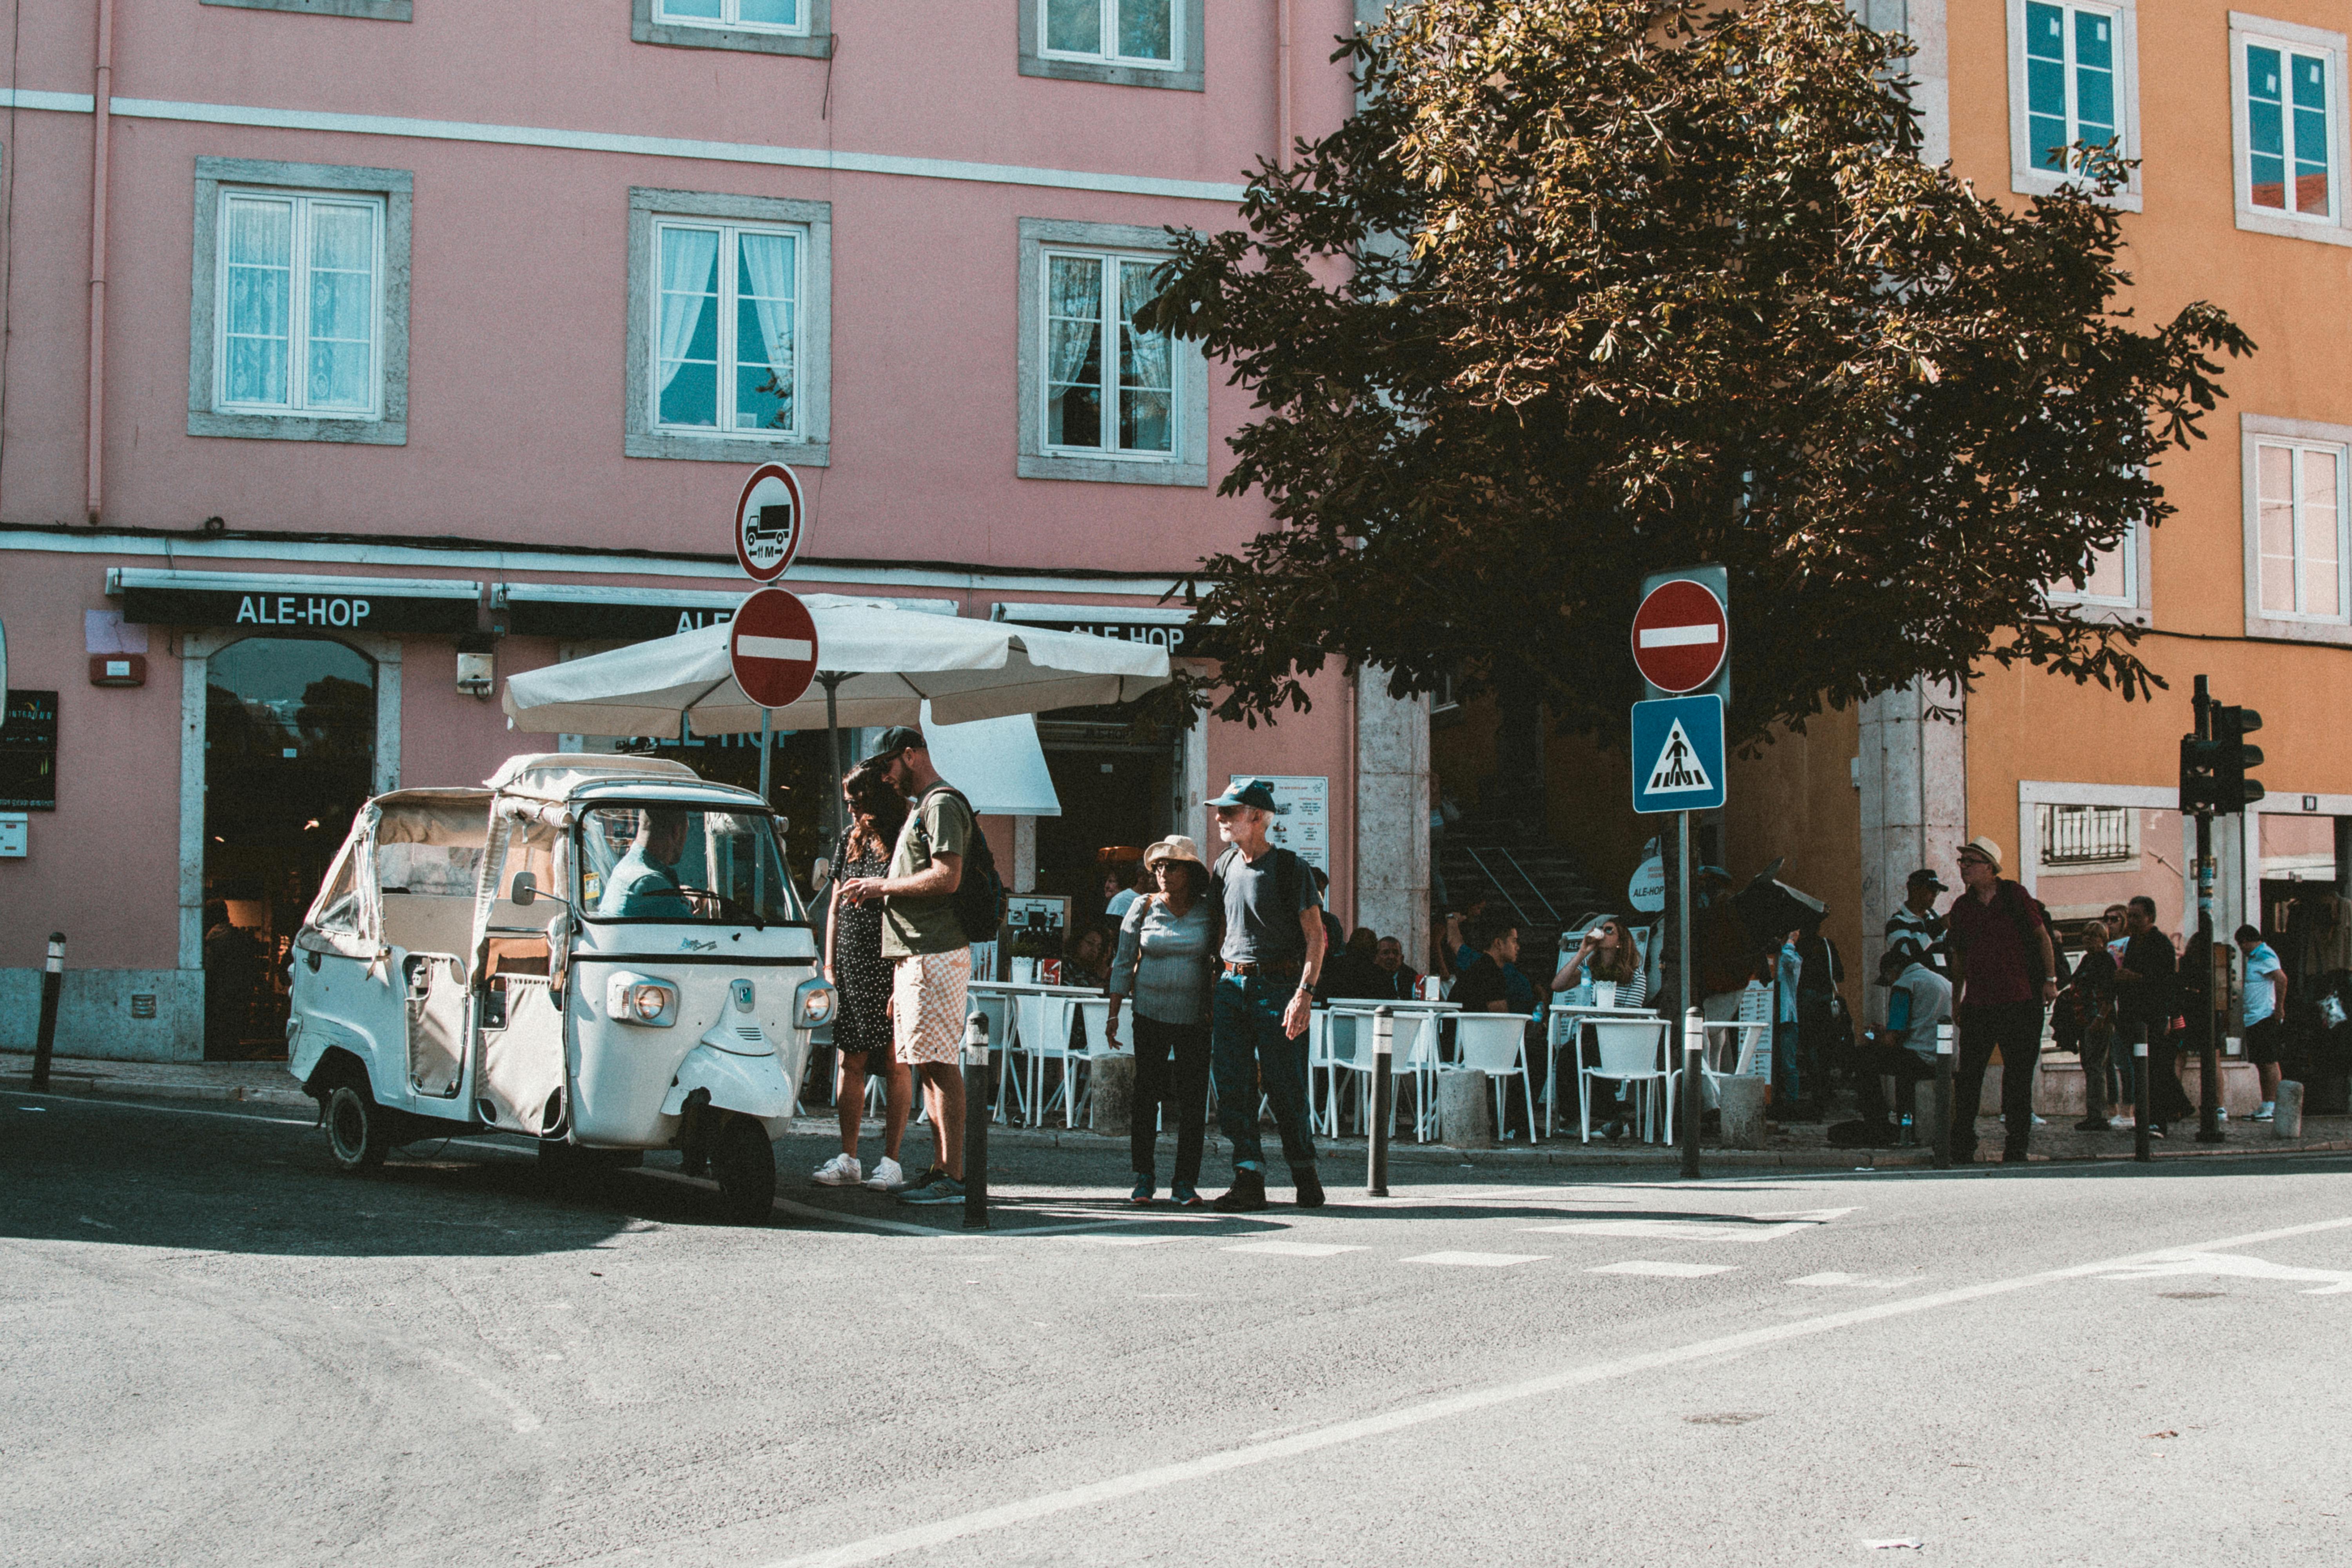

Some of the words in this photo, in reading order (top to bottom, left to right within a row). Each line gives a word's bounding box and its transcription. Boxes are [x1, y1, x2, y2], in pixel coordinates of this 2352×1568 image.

[765, 546, 774, 557] M
[236, 596, 370, 626] ALE-HOP
[1633, 886, 1664, 897] ALE-HOP
